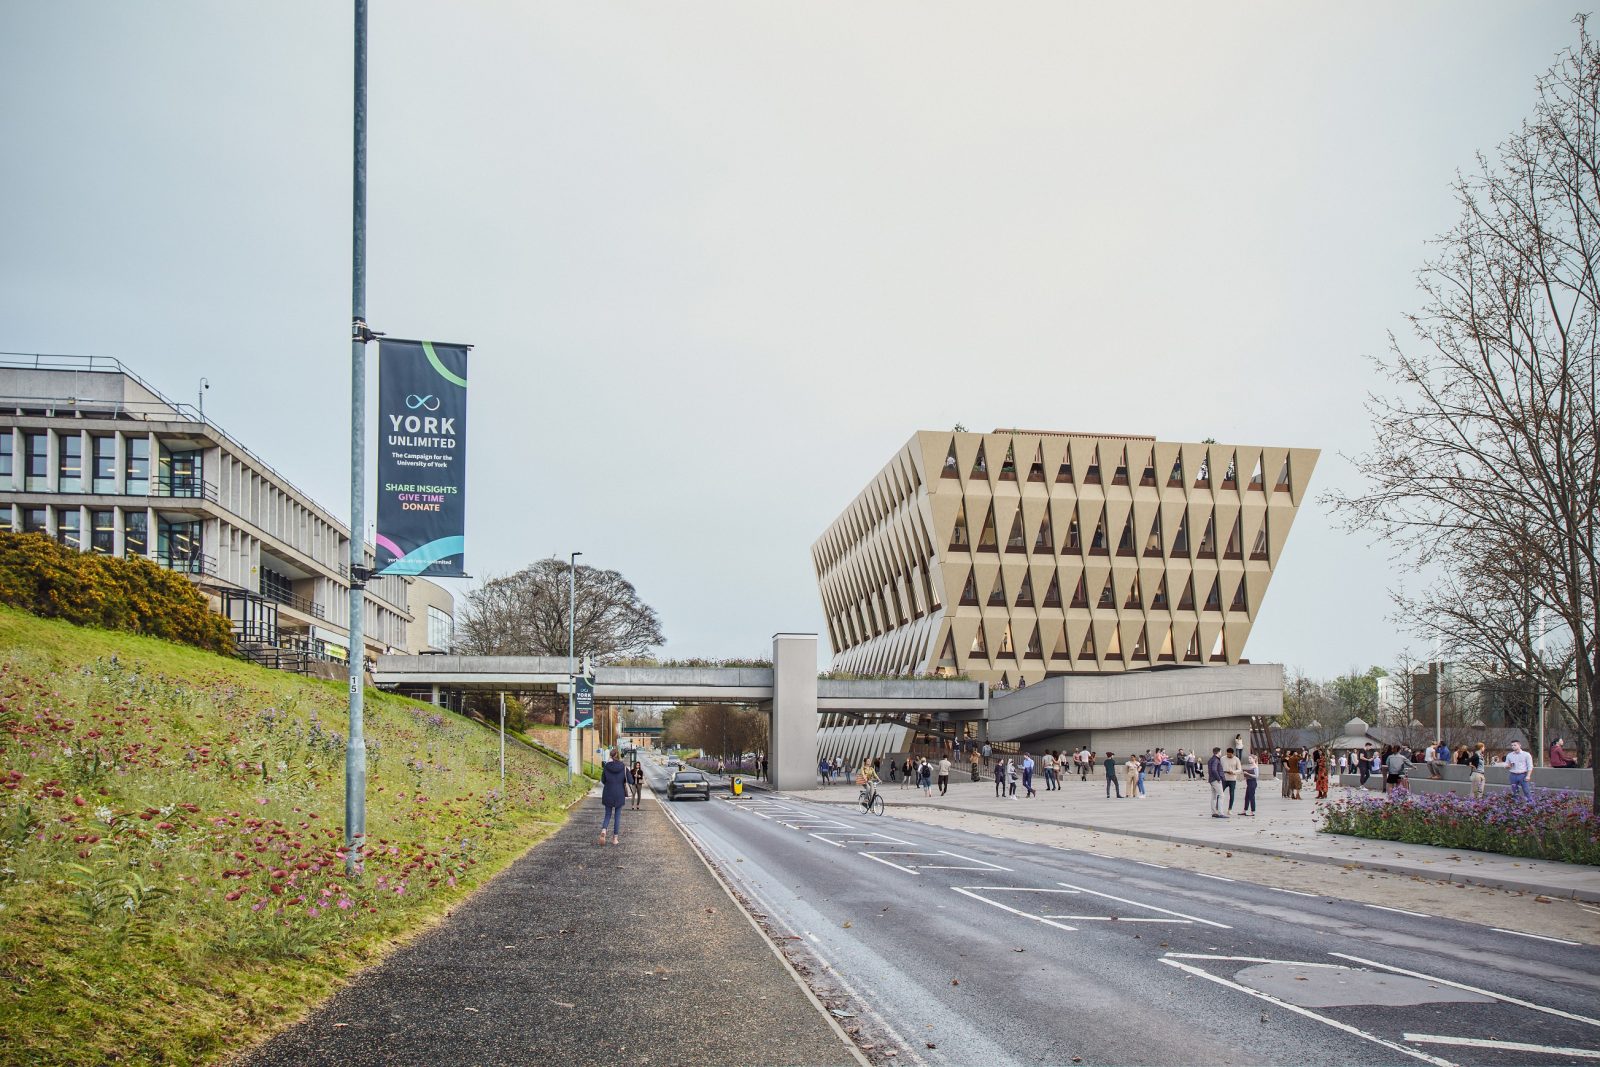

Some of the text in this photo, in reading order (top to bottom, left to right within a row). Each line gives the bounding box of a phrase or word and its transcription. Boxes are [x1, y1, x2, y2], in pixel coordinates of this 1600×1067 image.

[389, 414, 456, 435] YORK
[388, 435, 456, 448] UNLIMITED
[404, 453, 433, 461] Campaign
[397, 460, 427, 468] University
[385, 483, 458, 494] SHARE INSIGHTS
[398, 493, 445, 503] GIVE TIME
[402, 502, 440, 512] DONATE
